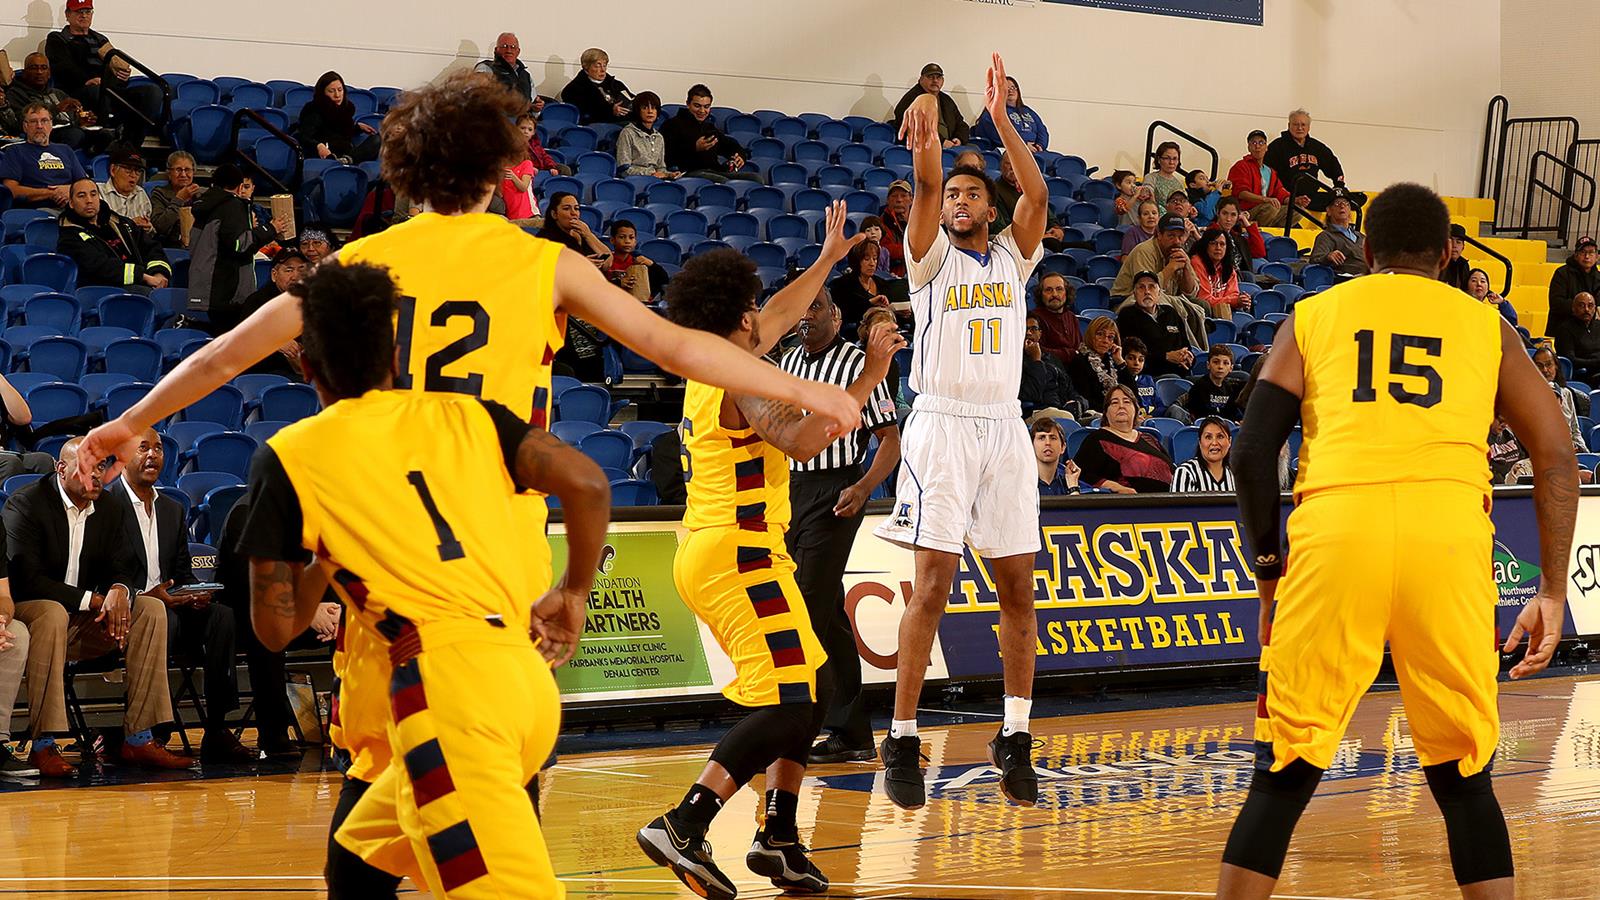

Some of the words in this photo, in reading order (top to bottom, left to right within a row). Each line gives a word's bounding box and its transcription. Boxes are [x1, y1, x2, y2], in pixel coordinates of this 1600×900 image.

[944, 282, 1013, 312] ALASKA
[392, 295, 490, 396] 12
[968, 318, 1002, 354] 11
[1352, 329, 1443, 409] 15
[406, 471, 466, 562] 1
[1498, 596, 1520, 606] thletic
[1500, 586, 1538, 596] Northwest
[584, 612, 661, 633] ARTNERS
[582, 646, 613, 655] TANANA
[614, 644, 641, 653] VALLEY
[643, 642, 667, 651] CLINIC
[569, 658, 609, 668] FAIRBANKS
[610, 656, 649, 666] MEMORIAL
[650, 654, 685, 664] HOSPITAL
[604, 669, 631, 679] DENALI
[631, 667, 660, 677] CENTER
